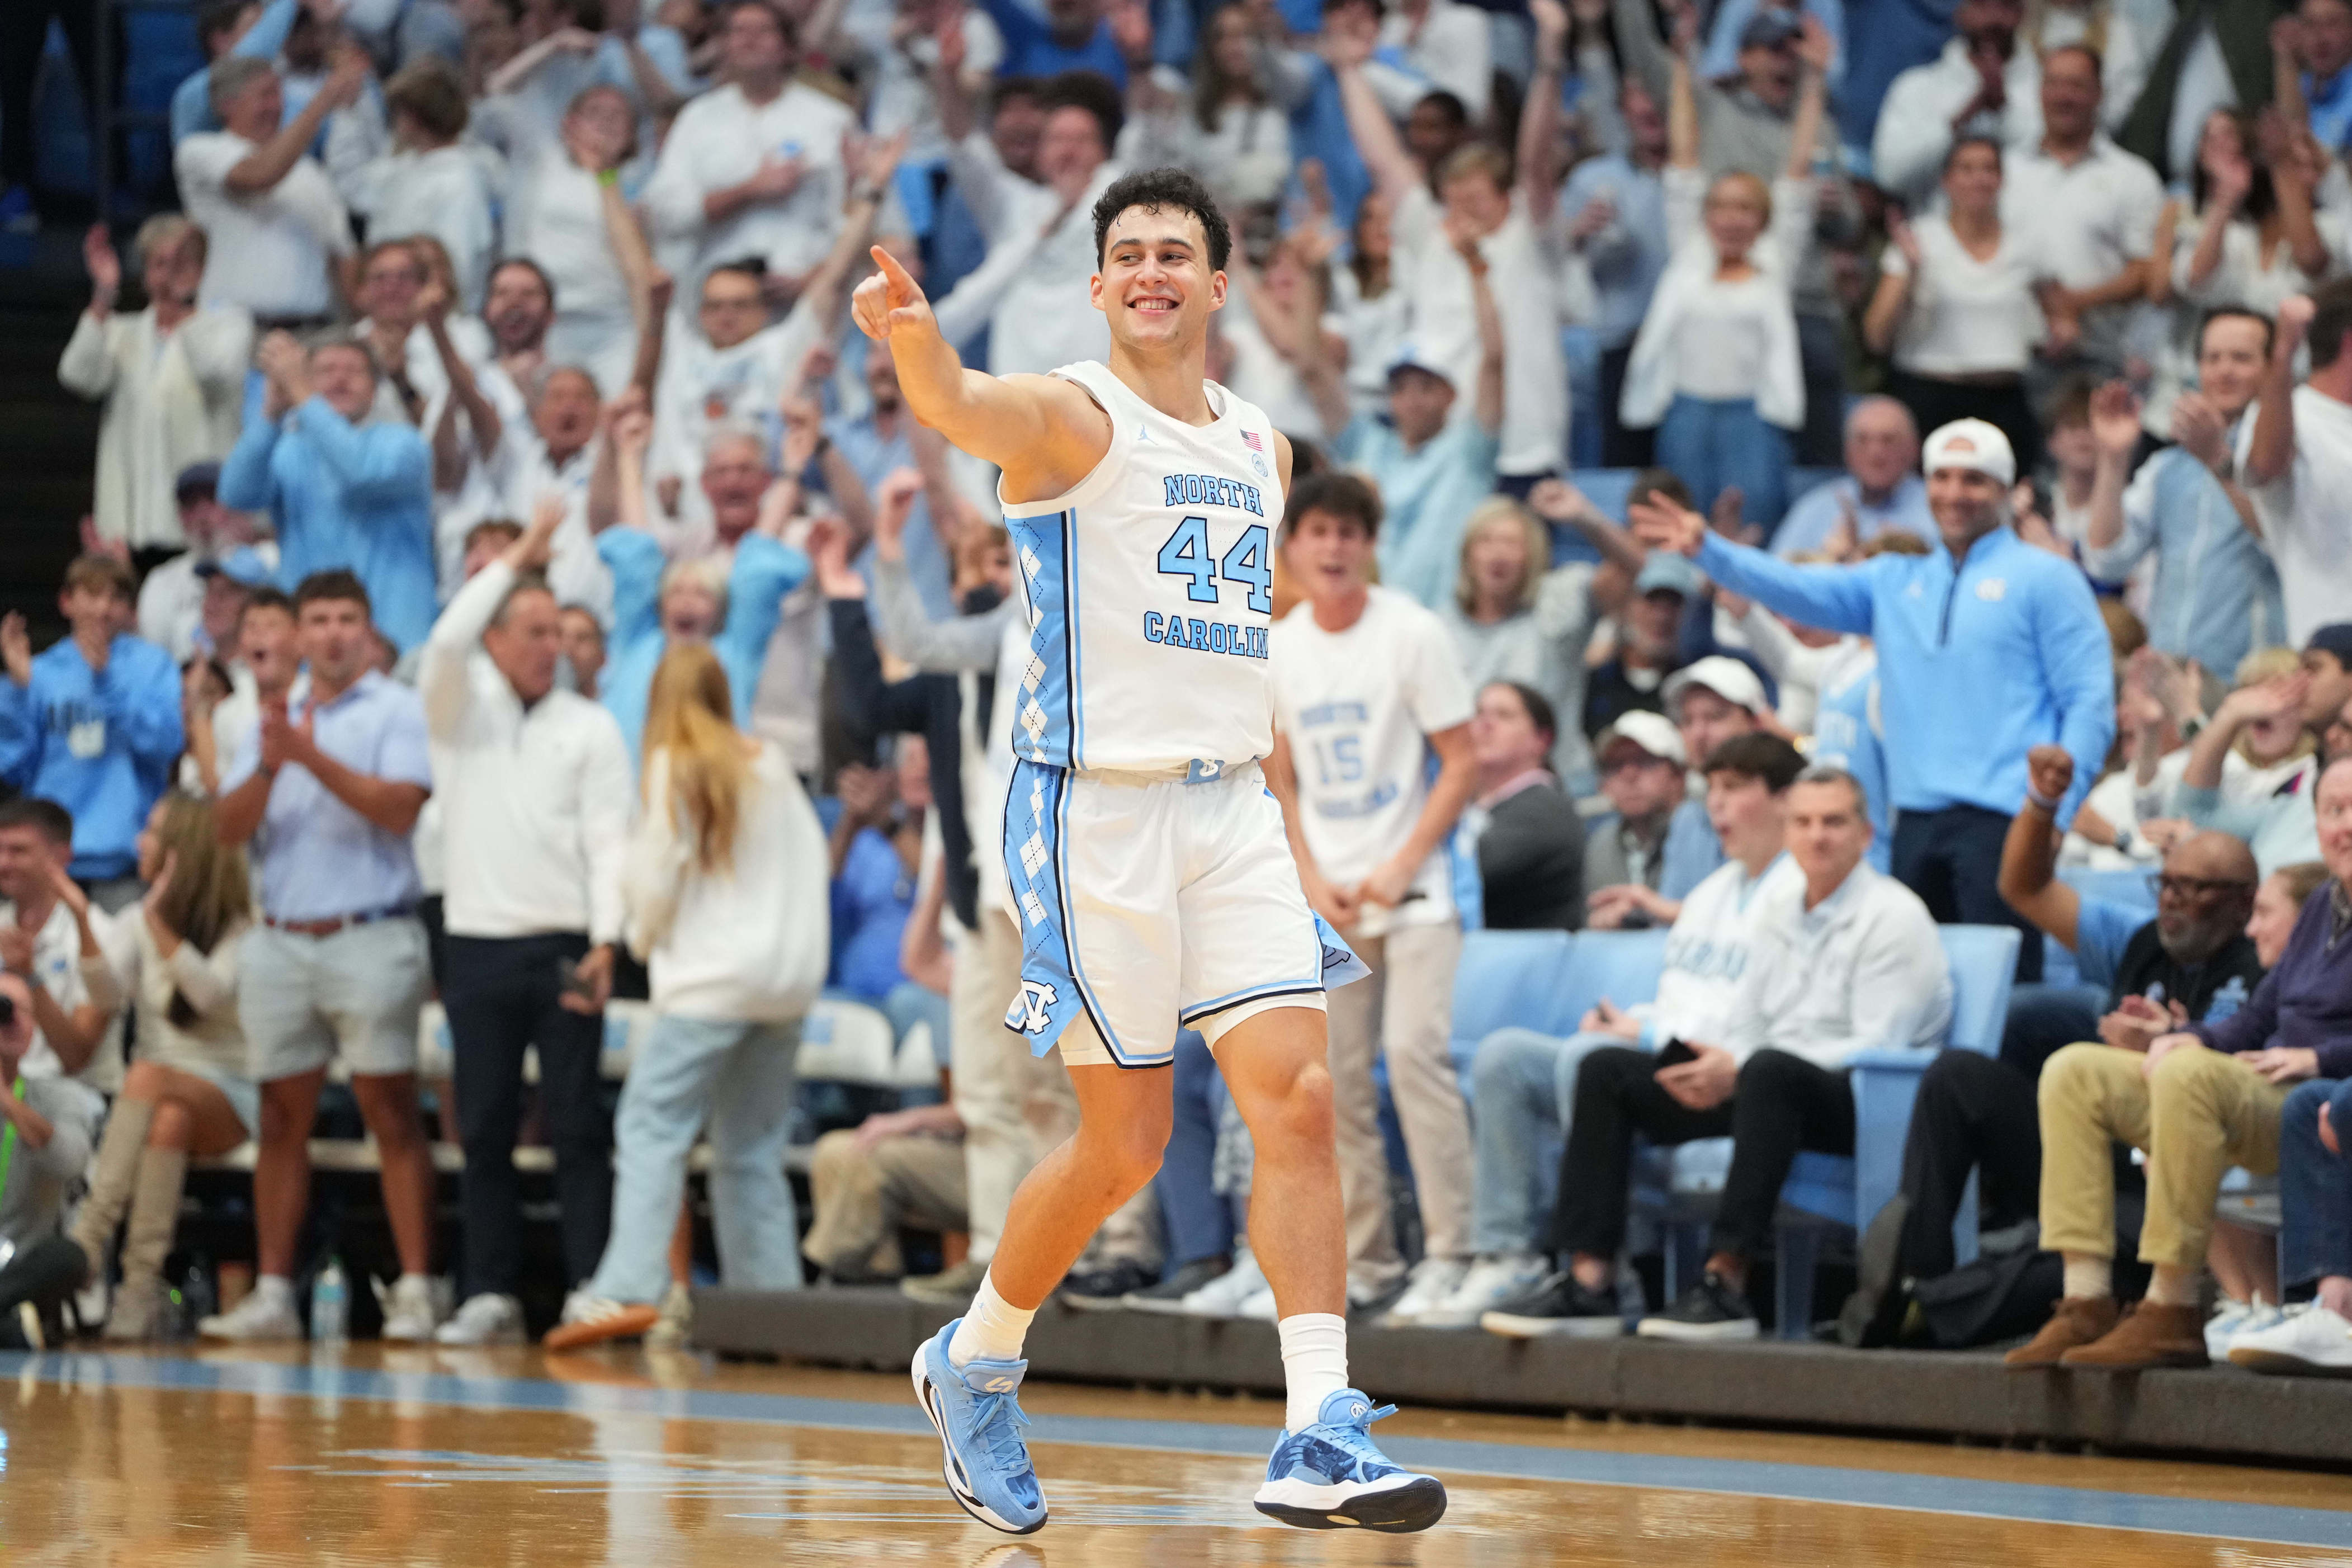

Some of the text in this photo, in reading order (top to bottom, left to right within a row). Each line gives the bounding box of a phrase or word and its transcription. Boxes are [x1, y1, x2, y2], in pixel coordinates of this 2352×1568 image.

[1164, 474, 1264, 517] NORTH
[1158, 516, 1272, 615] 44
[1144, 611, 1268, 659] CAROLIN
